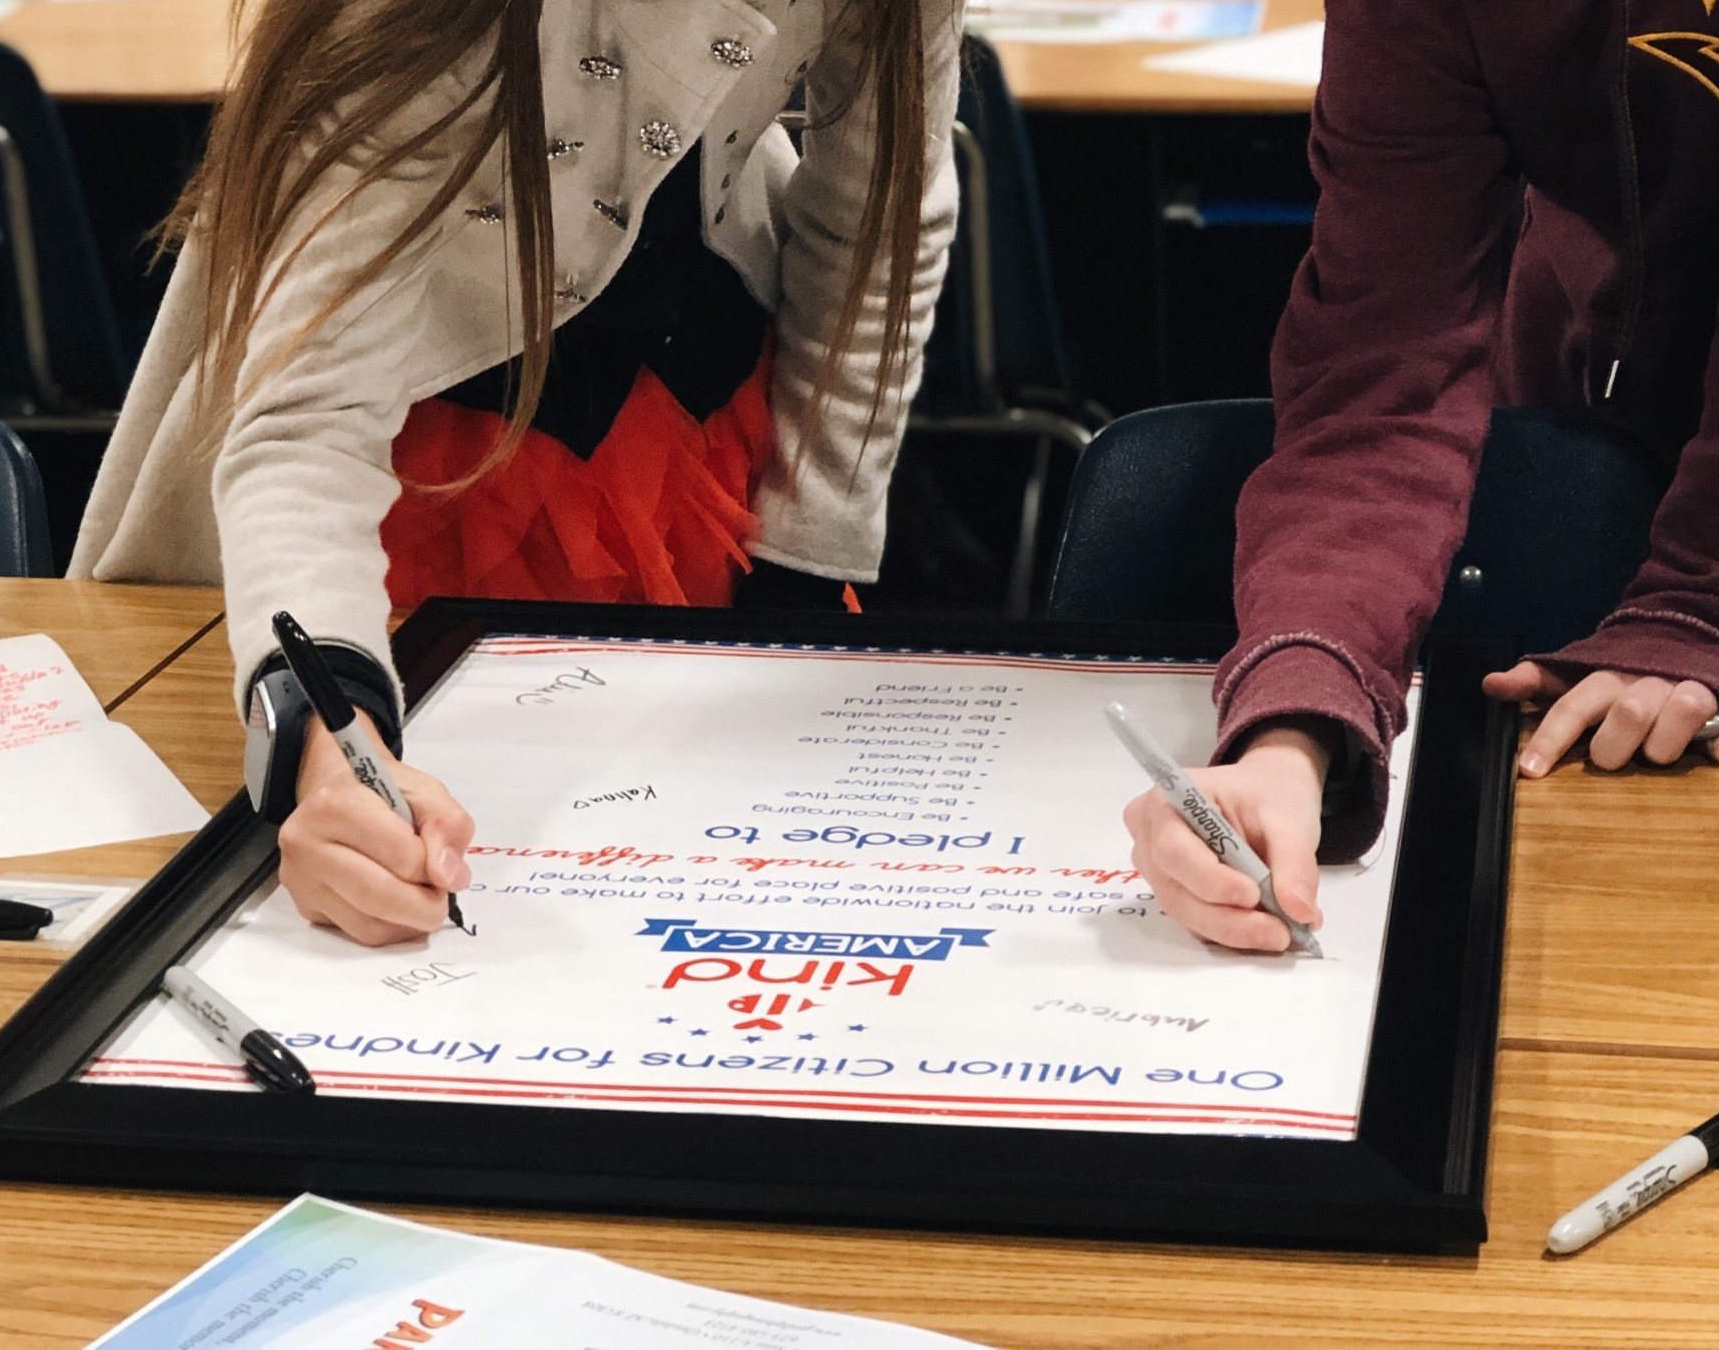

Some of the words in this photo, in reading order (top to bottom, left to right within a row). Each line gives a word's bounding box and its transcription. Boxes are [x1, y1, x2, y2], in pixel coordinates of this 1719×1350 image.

[875, 684, 952, 694] Friend
[979, 684, 1008, 694] Be
[843, 697, 968, 707] Respectful
[974, 699, 1002, 708] Be
[820, 710, 961, 722] Responsible
[968, 713, 996, 723] Be
[845, 724, 953, 735] Thankful
[961, 728, 990, 736] Be
[798, 736, 948, 749] Considerate
[955, 741, 984, 750] Be
[858, 752, 942, 762] Honest
[948, 755, 977, 763] Be
[848, 766, 936, 777] Helpful
[942, 769, 971, 778] Be
[834, 779, 928, 790] Positive
[935, 782, 965, 791] Be
[784, 790, 921, 806] Supportive
[929, 797, 958, 806] Be
[751, 804, 915, 821] Encouraging
[921, 813, 951, 822] Be
[705, 826, 760, 845] to
[782, 826, 992, 852] pledge
[1008, 836, 1026, 854] I
[463, 846, 675, 870] difference
[686, 854, 718, 866] a
[729, 854, 858, 873] make
[869, 861, 964, 875] can
[977, 866, 1036, 876] we
[528, 871, 685, 885] everyone!
[693, 876, 742, 889] for
[495, 885, 551, 896] our
[752, 877, 840, 892] place
[849, 880, 972, 898] positive
[560, 888, 647, 900] make
[656, 891, 685, 903] to
[697, 891, 793, 906] effort
[980, 887, 1042, 899] and
[1050, 890, 1124, 901] safe
[803, 895, 975, 911] nationwide
[986, 902, 1036, 915] the
[1048, 903, 1108, 917] join
[1118, 906, 1147, 918] to
[684, 931, 940, 955] AMERICA
[662, 958, 914, 995] kind
[514, 1046, 615, 1070] for
[640, 1051, 895, 1078] Citizens
[916, 1059, 1123, 1087] Million
[1145, 1068, 1284, 1091] One
